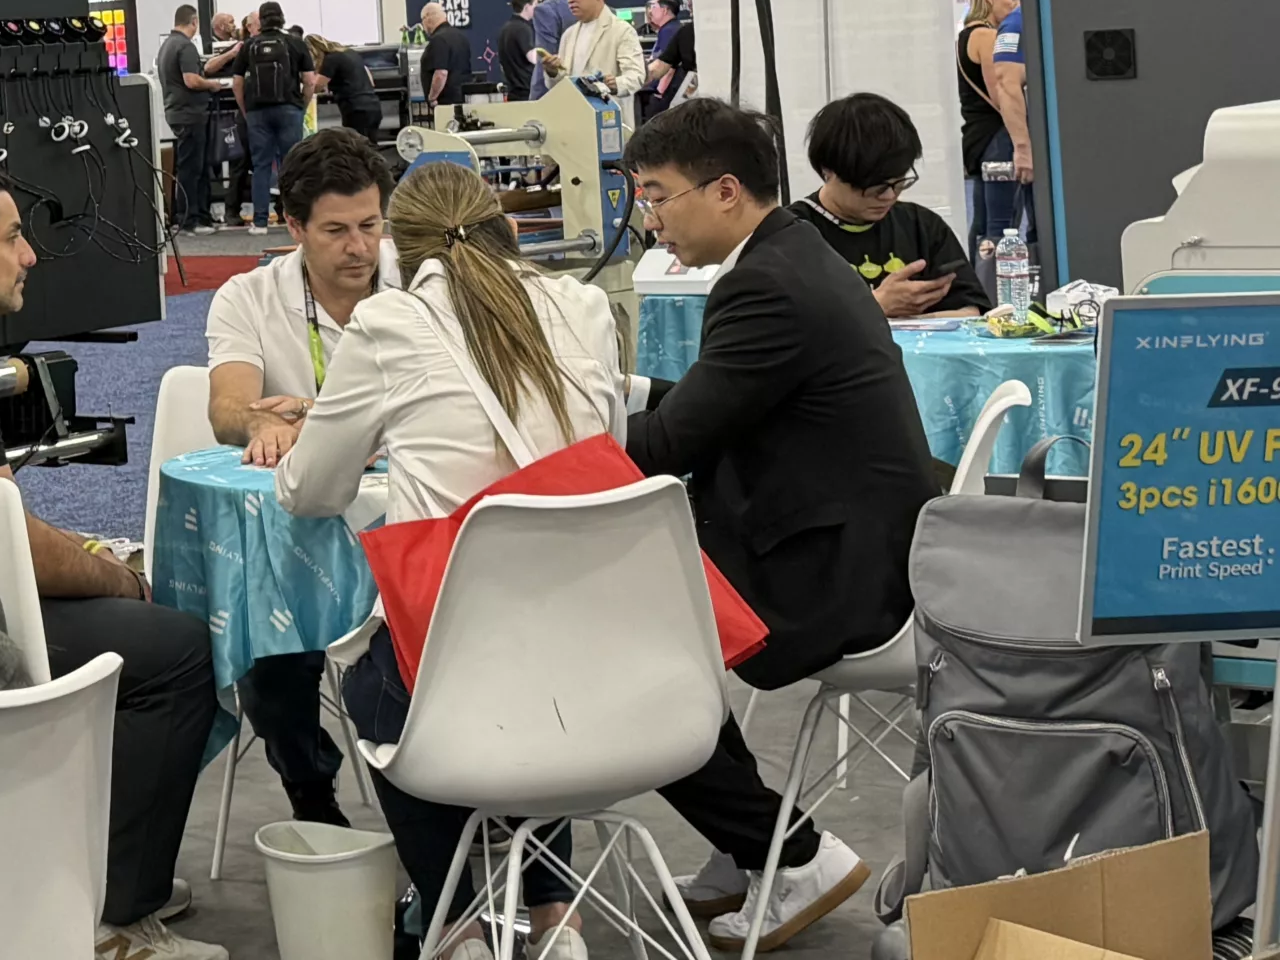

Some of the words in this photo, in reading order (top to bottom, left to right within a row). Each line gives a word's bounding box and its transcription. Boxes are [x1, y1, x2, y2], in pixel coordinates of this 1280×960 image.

[447, 9, 470, 27] 025
[1135, 333, 1265, 350] XINFLYING
[1198, 429, 1255, 465] UV
[1118, 481, 1199, 515] 3pcs
[1208, 476, 1280, 506] i160
[1162, 534, 1265, 560] Fastest
[1158, 562, 1203, 580] Print
[1208, 558, 1263, 581] Speed
